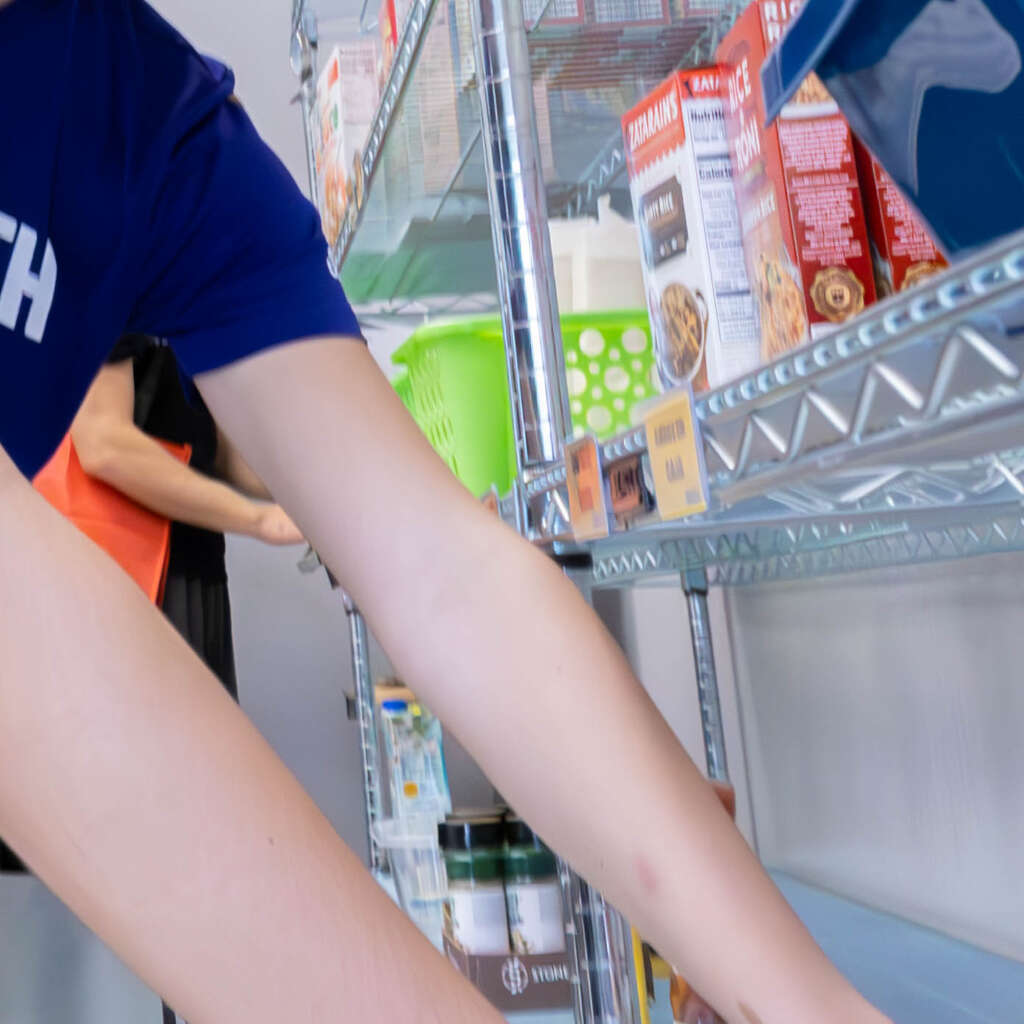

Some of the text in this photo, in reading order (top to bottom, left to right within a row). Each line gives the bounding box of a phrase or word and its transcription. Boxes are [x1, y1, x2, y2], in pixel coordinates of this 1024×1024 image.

[763, 0, 802, 24] RIC
[728, 57, 751, 114] RICE
[735, 114, 761, 173] RONI
